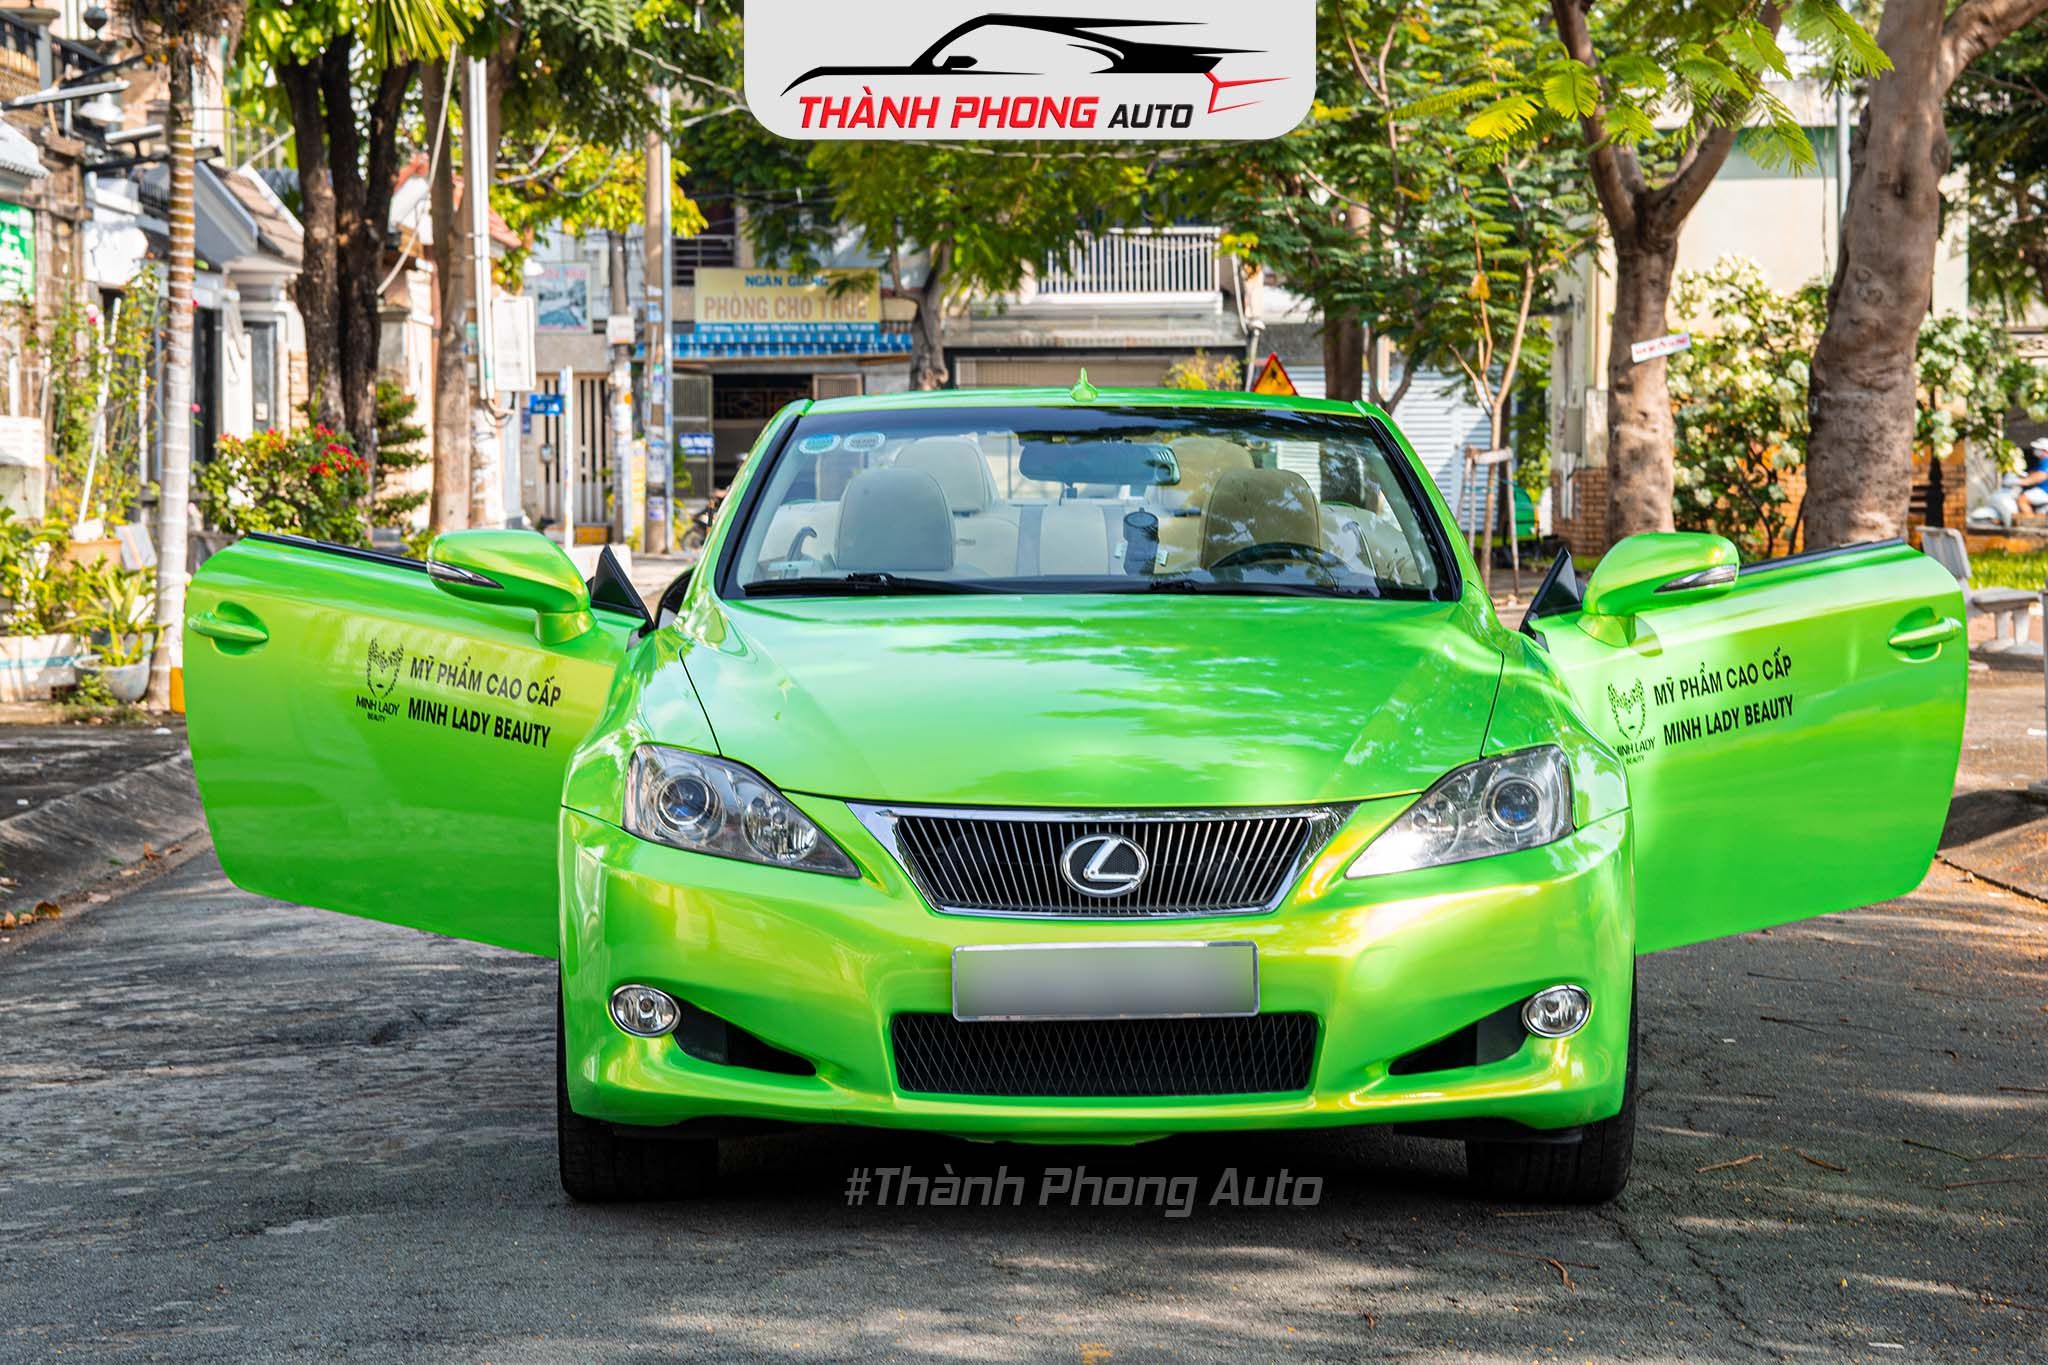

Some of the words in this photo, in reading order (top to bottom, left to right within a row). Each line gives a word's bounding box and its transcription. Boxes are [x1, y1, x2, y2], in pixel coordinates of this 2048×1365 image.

[774, 295, 813, 320] CHO
[409, 655, 435, 681] MỸ
[436, 655, 483, 693] PHẨM
[486, 673, 523, 700] CAO
[526, 675, 562, 708] CẤP
[1653, 676, 1675, 706] MỸ
[1680, 661, 1723, 700] PHẨM
[1726, 663, 1758, 689] CAO
[1762, 646, 1792, 681] CẤP
[355, 695, 377, 711] MINH
[378, 700, 400, 717] LADY
[407, 697, 449, 726] MINH
[452, 706, 491, 735] LADY
[493, 713, 552, 748] BEAUTY
[1663, 717, 1702, 746] MINH
[1705, 707, 1741, 736] LADY
[1745, 694, 1794, 729] BEAUTY
[1635, 736, 1656, 753] LADY
